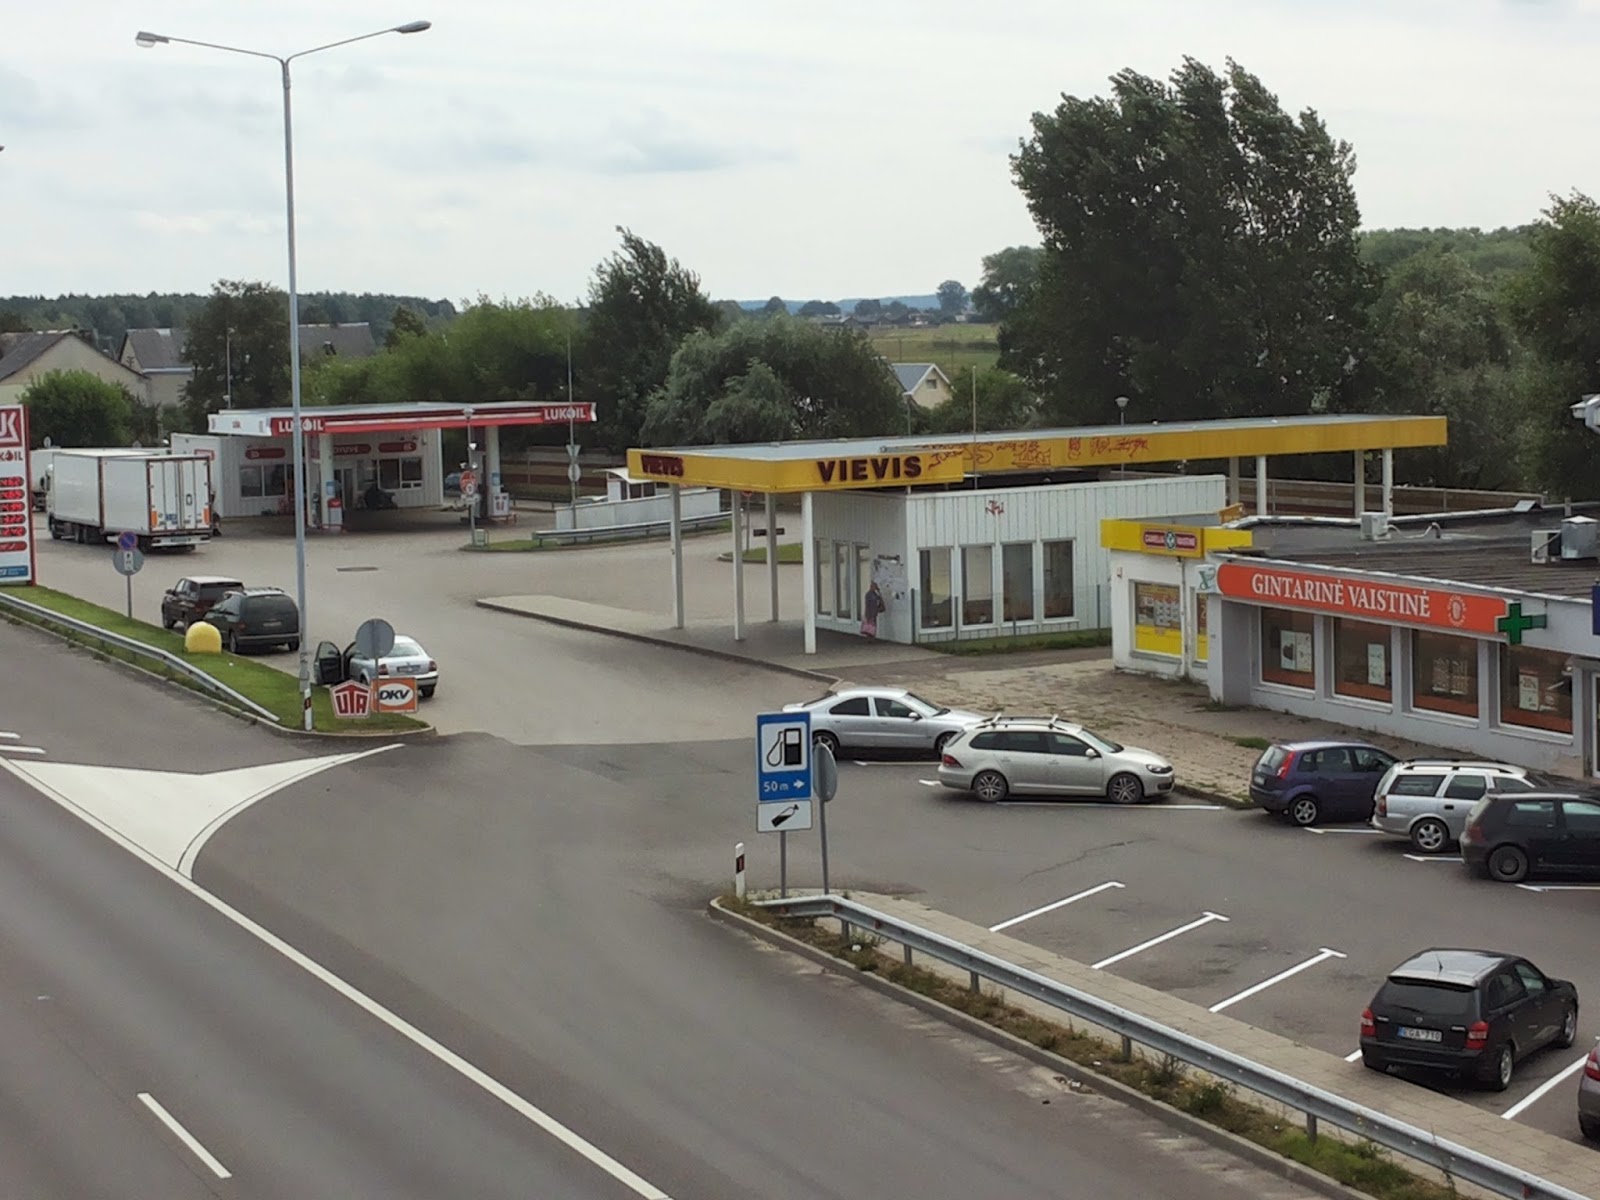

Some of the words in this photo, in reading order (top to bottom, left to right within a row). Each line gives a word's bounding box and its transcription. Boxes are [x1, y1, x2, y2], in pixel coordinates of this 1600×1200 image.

[544, 401, 586, 420] LUKOIL
[278, 418, 324, 433] LUOIL
[817, 456, 922, 484] VIEVIS
[1251, 573, 1345, 606] GINTARINĖ
[1348, 585, 1431, 618] VAISTINĖ
[334, 683, 370, 714] UTA
[379, 690, 410, 700] DKV
[763, 781, 779, 792] 50
